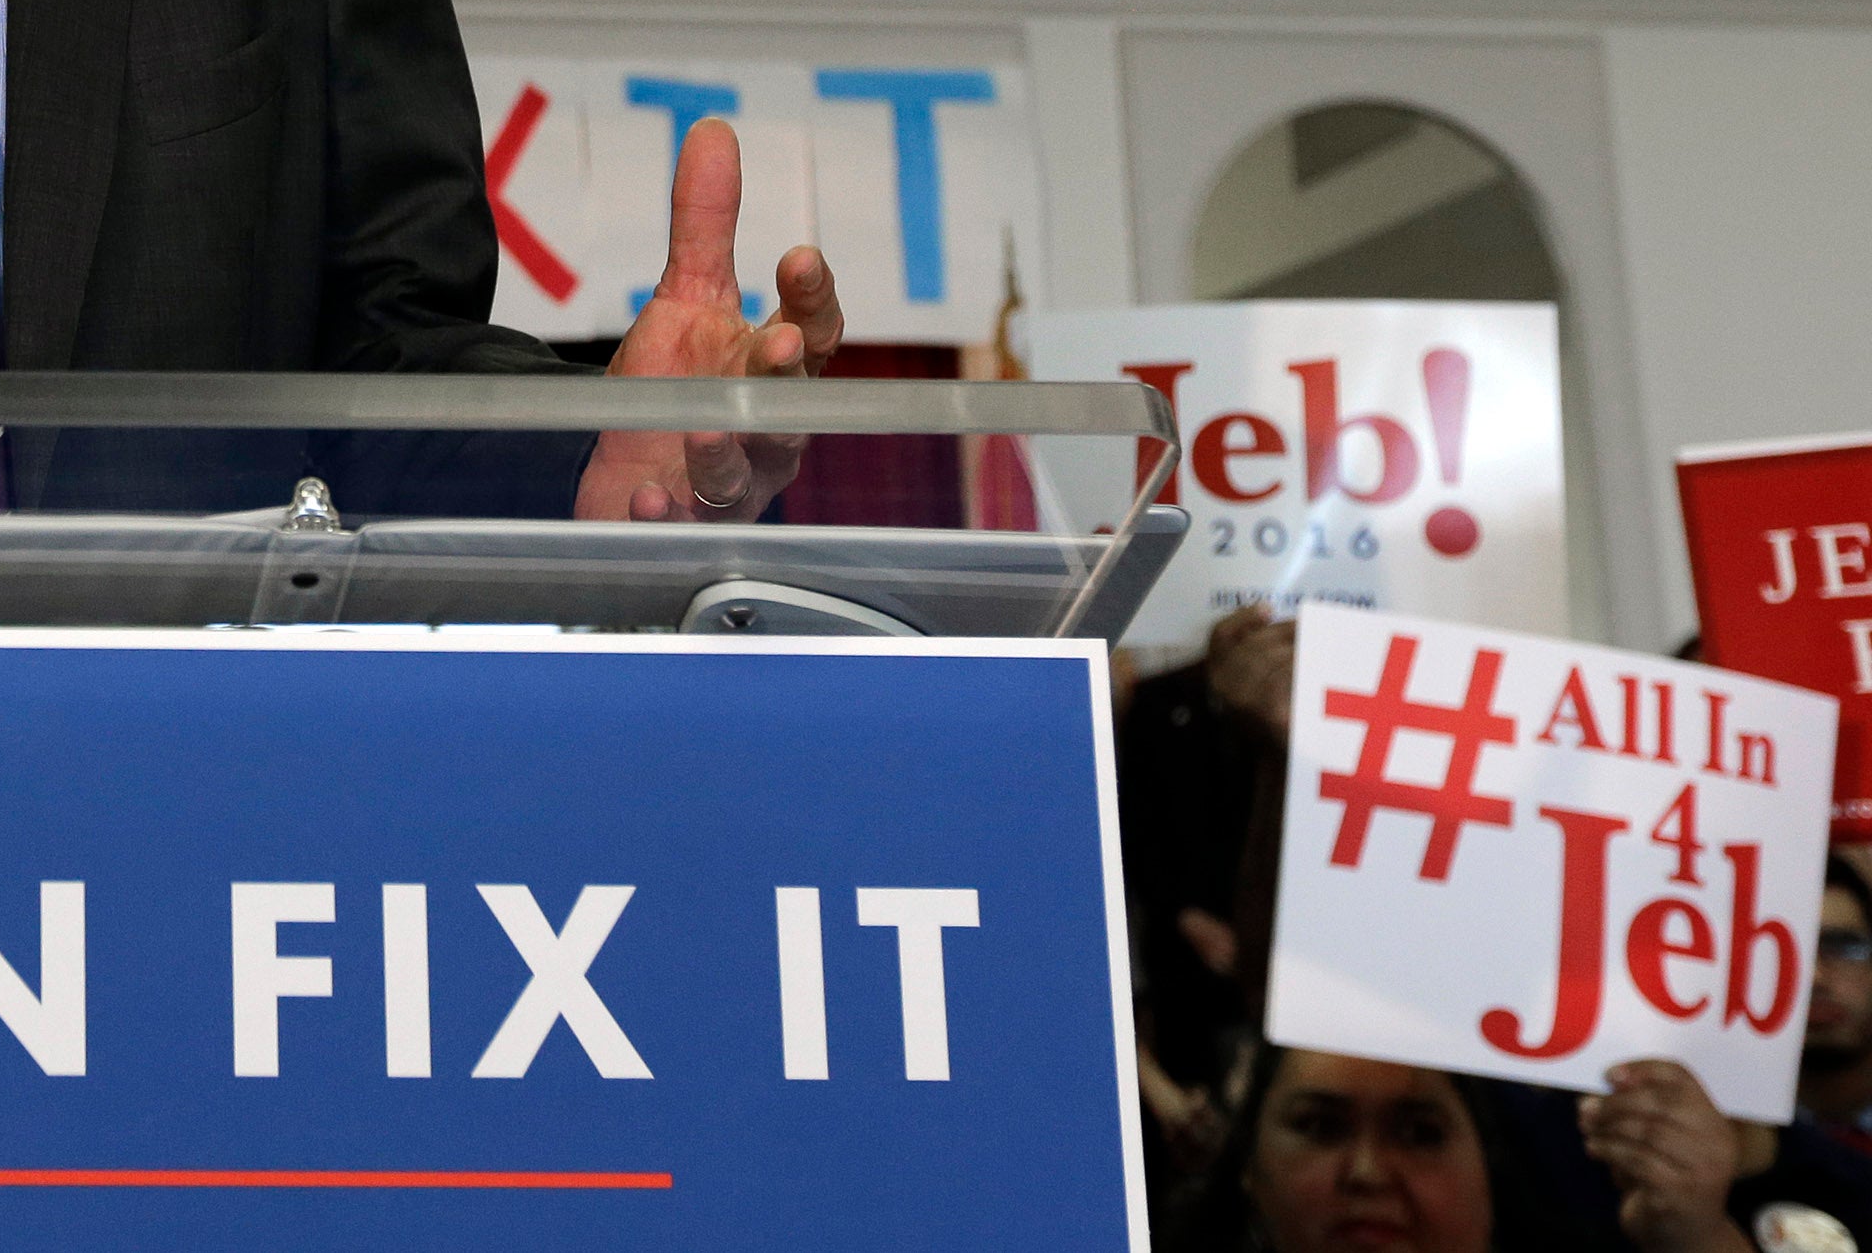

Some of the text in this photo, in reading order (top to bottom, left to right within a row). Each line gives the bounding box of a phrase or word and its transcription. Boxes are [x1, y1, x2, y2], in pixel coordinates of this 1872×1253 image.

[625, 69, 997, 320] IT
[1091, 347, 1482, 561] Jeb!
[1210, 516, 1381, 561] 2016
[1536, 665, 1779, 789] All In
[1479, 804, 1801, 1062] Jeb
[1650, 782, 1705, 887] 4
[231, 882, 655, 1081] FIX
[775, 886, 982, 1082] IT
